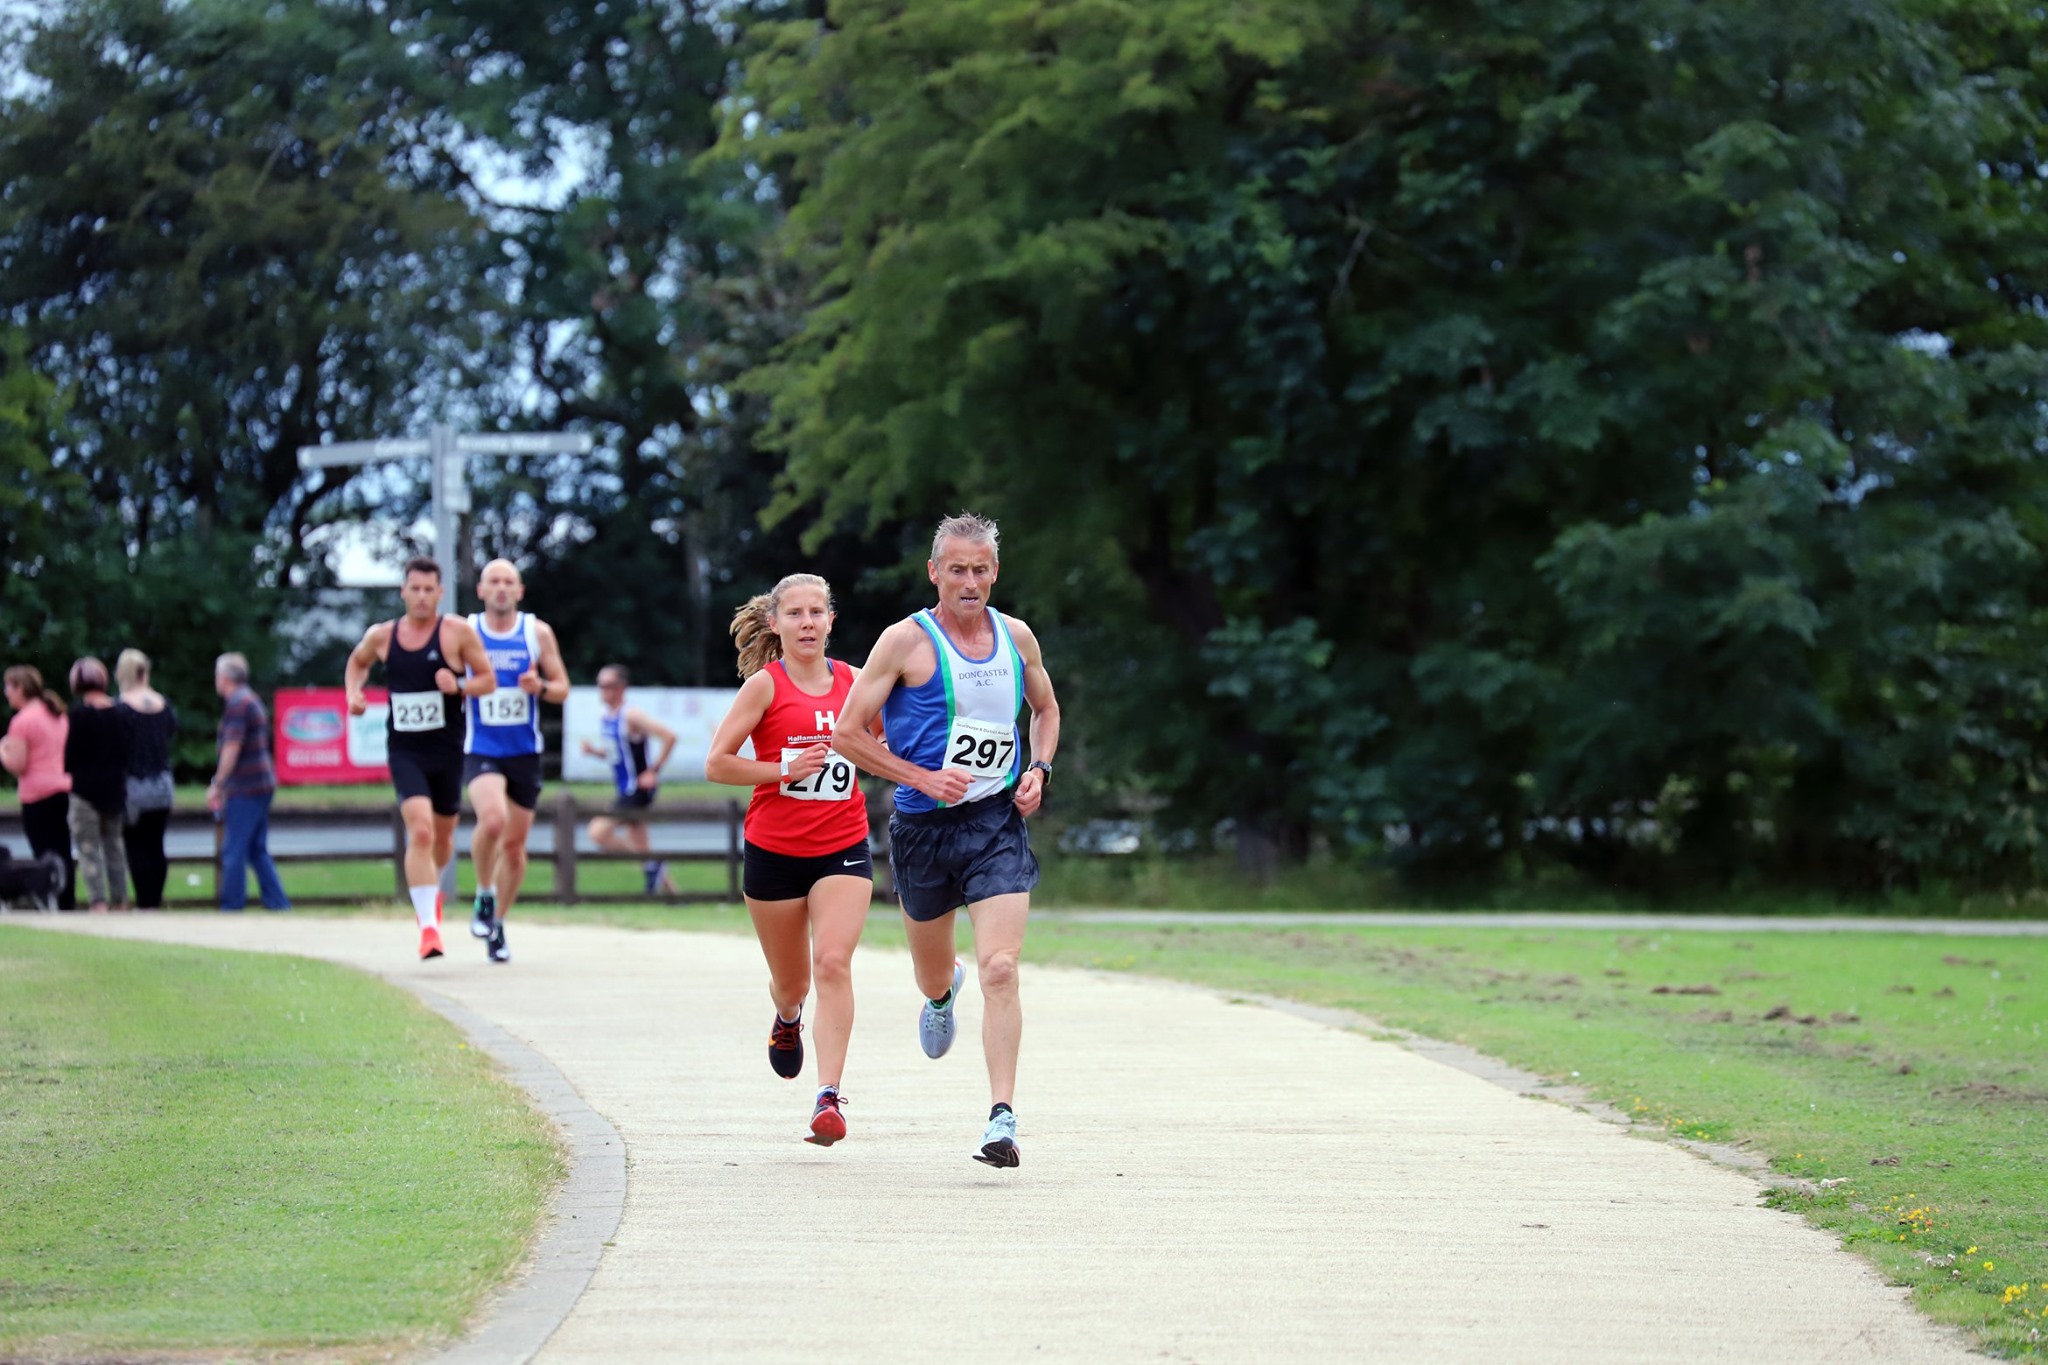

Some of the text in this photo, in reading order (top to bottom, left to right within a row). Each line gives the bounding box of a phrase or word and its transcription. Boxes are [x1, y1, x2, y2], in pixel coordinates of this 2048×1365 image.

[958, 668, 1008, 680] DONCASTER
[976, 679, 993, 687] A.C.
[397, 702, 438, 725] 232
[485, 698, 524, 720] 152
[787, 734, 832, 742] Hallamshire
[951, 734, 1014, 769] 297
